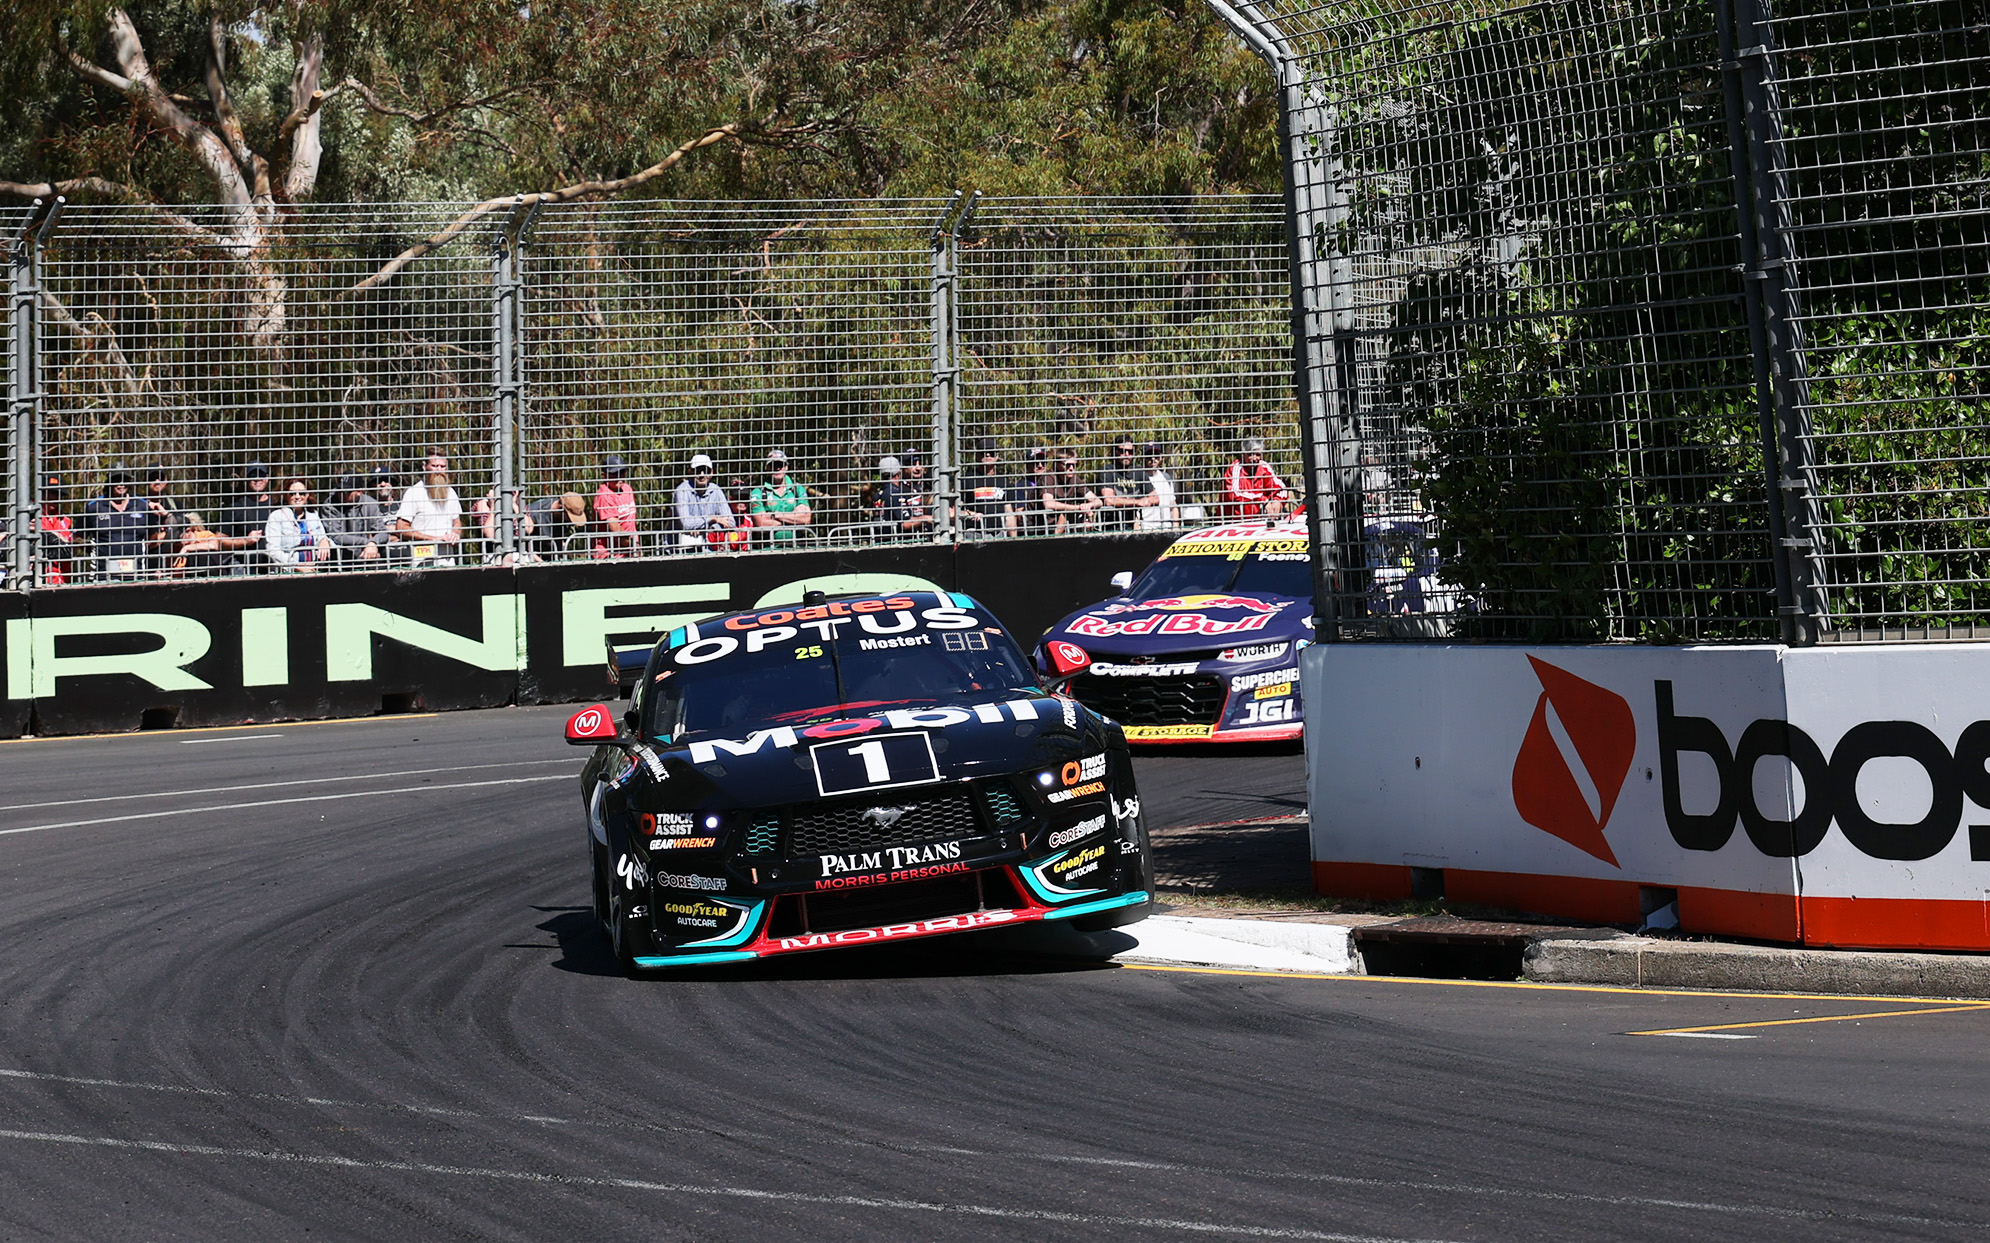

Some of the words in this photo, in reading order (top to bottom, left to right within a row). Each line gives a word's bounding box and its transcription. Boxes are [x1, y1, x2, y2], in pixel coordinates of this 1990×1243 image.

[1167, 542, 1247, 555] NATIONAL
[1226, 553, 1245, 562] 88
[1065, 614, 1167, 637] Red
[1157, 611, 1278, 636] Bull
[674, 607, 979, 665] OPTUS
[859, 633, 932, 651] Mostert
[794, 645, 823, 660] 25
[1258, 685, 1287, 697] AUTO
[688, 699, 1040, 765] Mobil
[1140, 726, 1208, 737] STORAGE
[848, 741, 891, 784] 1
[1080, 752, 1106, 771] TRUCK
[1079, 764, 1106, 782] ASSIST
[1047, 781, 1106, 804] GEARWRENCH
[656, 813, 694, 825] TRUCK
[655, 824, 694, 836] ASSIST
[649, 837, 717, 851] GEARWRENCH
[820, 851, 883, 877] PALM
[885, 840, 962, 870] TRANS
[1053, 845, 1106, 874] GOODYEAR
[815, 872, 888, 890] MORRIS
[890, 861, 970, 882] PERSONAL
[1065, 861, 1099, 882] AUTOCARE
[664, 902, 729, 918] GOODYEAR
[677, 916, 718, 928] AUTOCARE
[779, 908, 1018, 950] MORRIS
